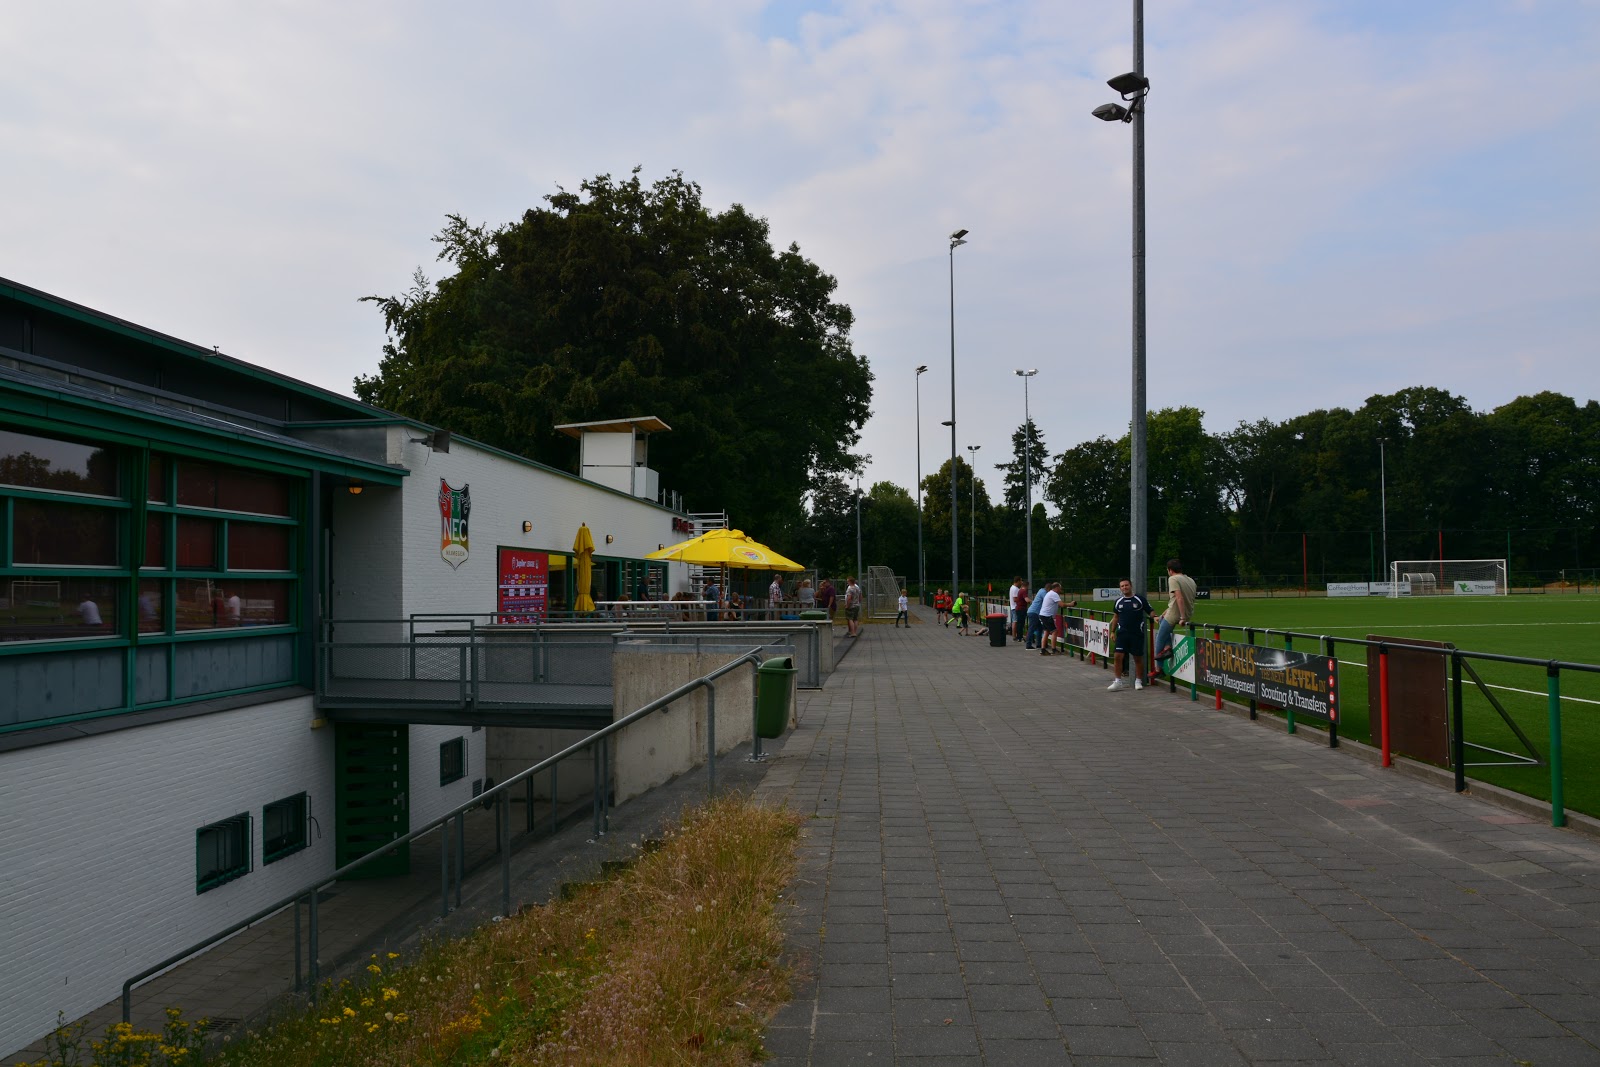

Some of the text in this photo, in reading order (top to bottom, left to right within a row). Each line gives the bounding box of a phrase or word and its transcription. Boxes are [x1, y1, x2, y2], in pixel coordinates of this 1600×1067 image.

[443, 517, 467, 542] NEC
[1205, 641, 1255, 677] FUTURALIS
[1223, 673, 1256, 694] Management
[1285, 666, 1318, 692] LEVEL
[1318, 679, 1326, 693] IN
[1261, 682, 1327, 714] Scouting & Transfers
